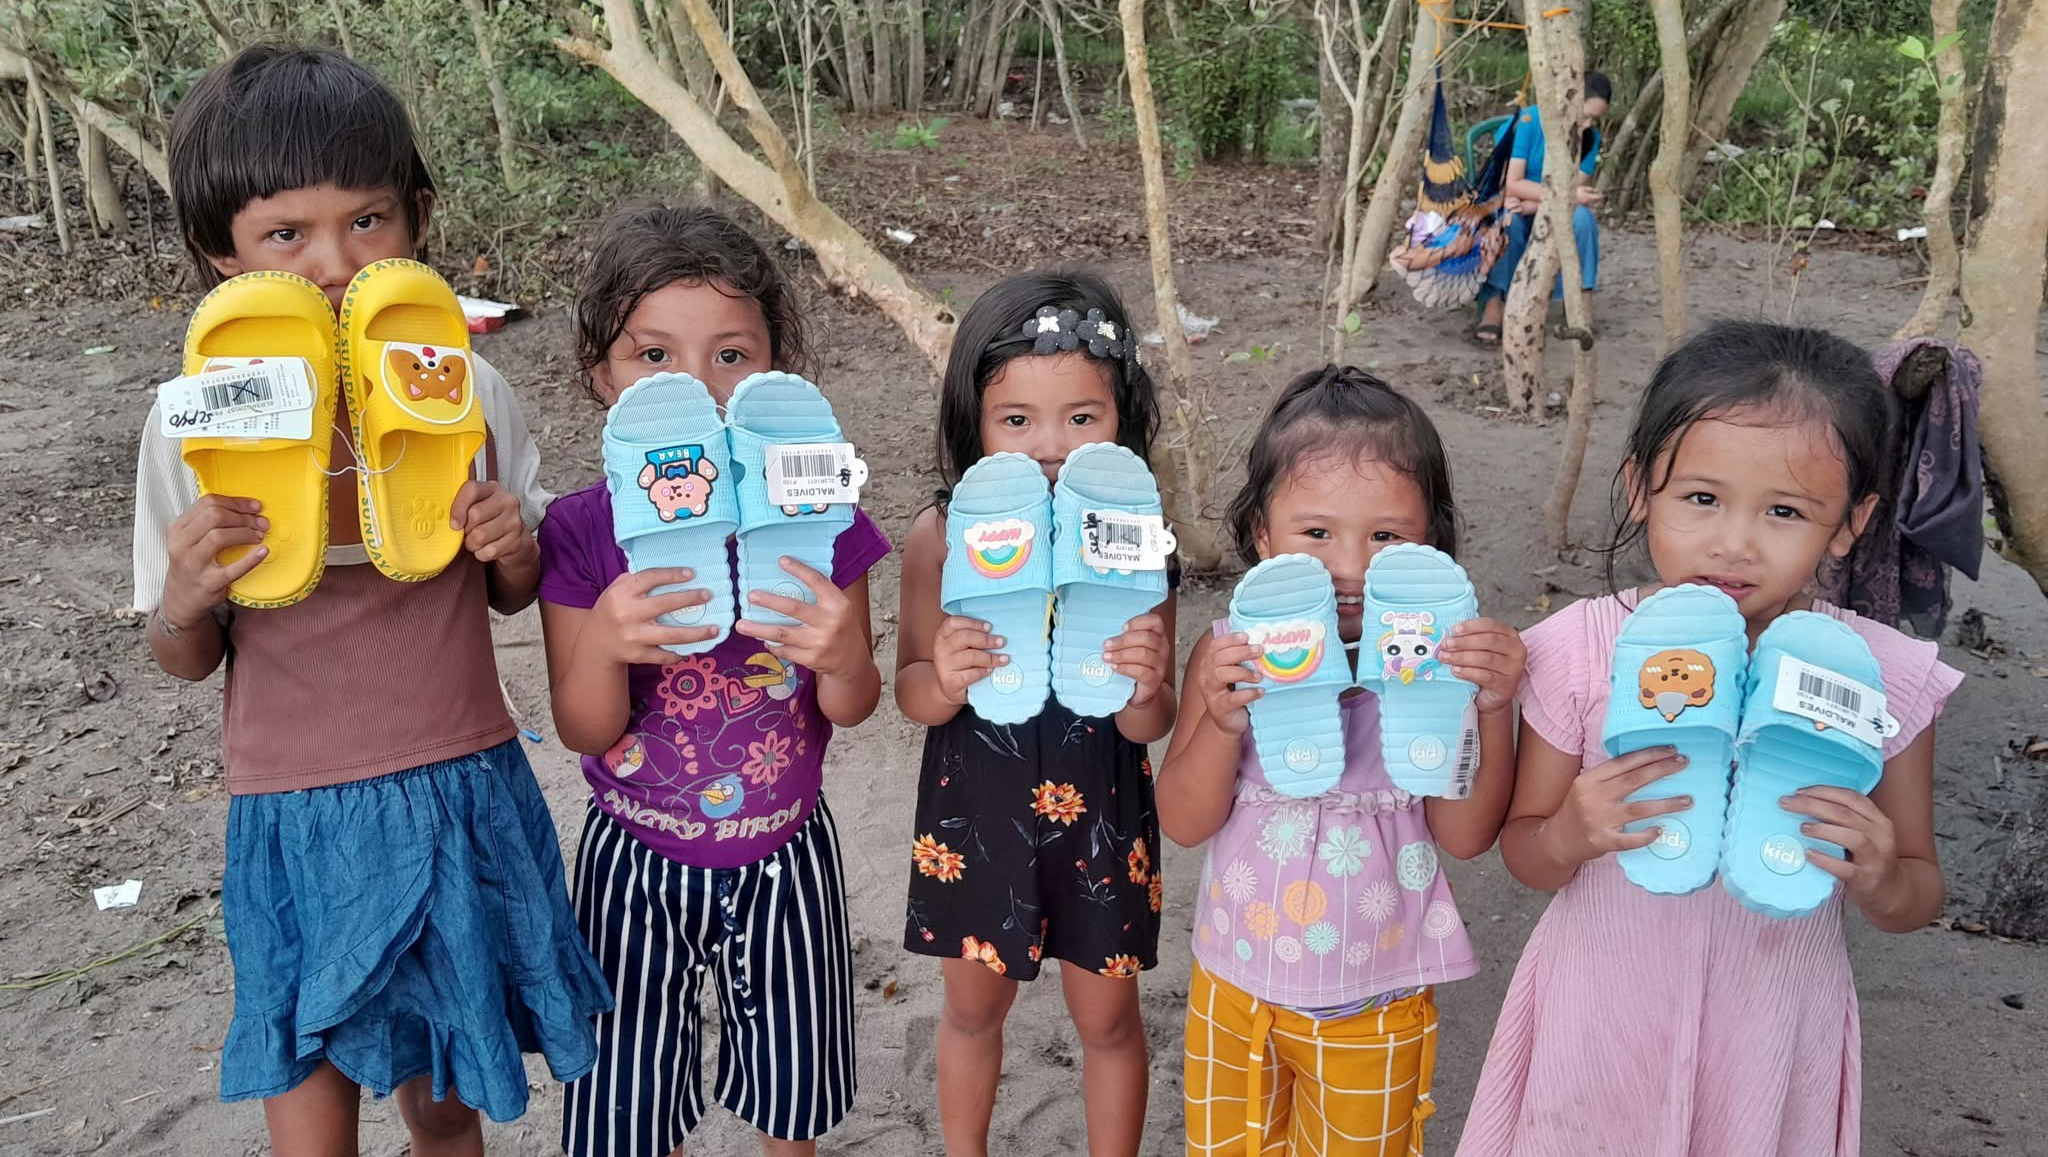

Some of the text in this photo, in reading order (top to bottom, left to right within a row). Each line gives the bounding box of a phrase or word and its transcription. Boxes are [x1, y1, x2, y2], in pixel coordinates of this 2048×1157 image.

[340, 338, 359, 418] SUNDAY
[657, 447, 690, 461] BEAR
[786, 487, 836, 497] MALDIVES
[1098, 551, 1141, 562] MALDIVES
[1798, 700, 1857, 729] MALDIVES
[603, 788, 802, 841] ANGRY BIRDS
[1763, 841, 1803, 868] kids
